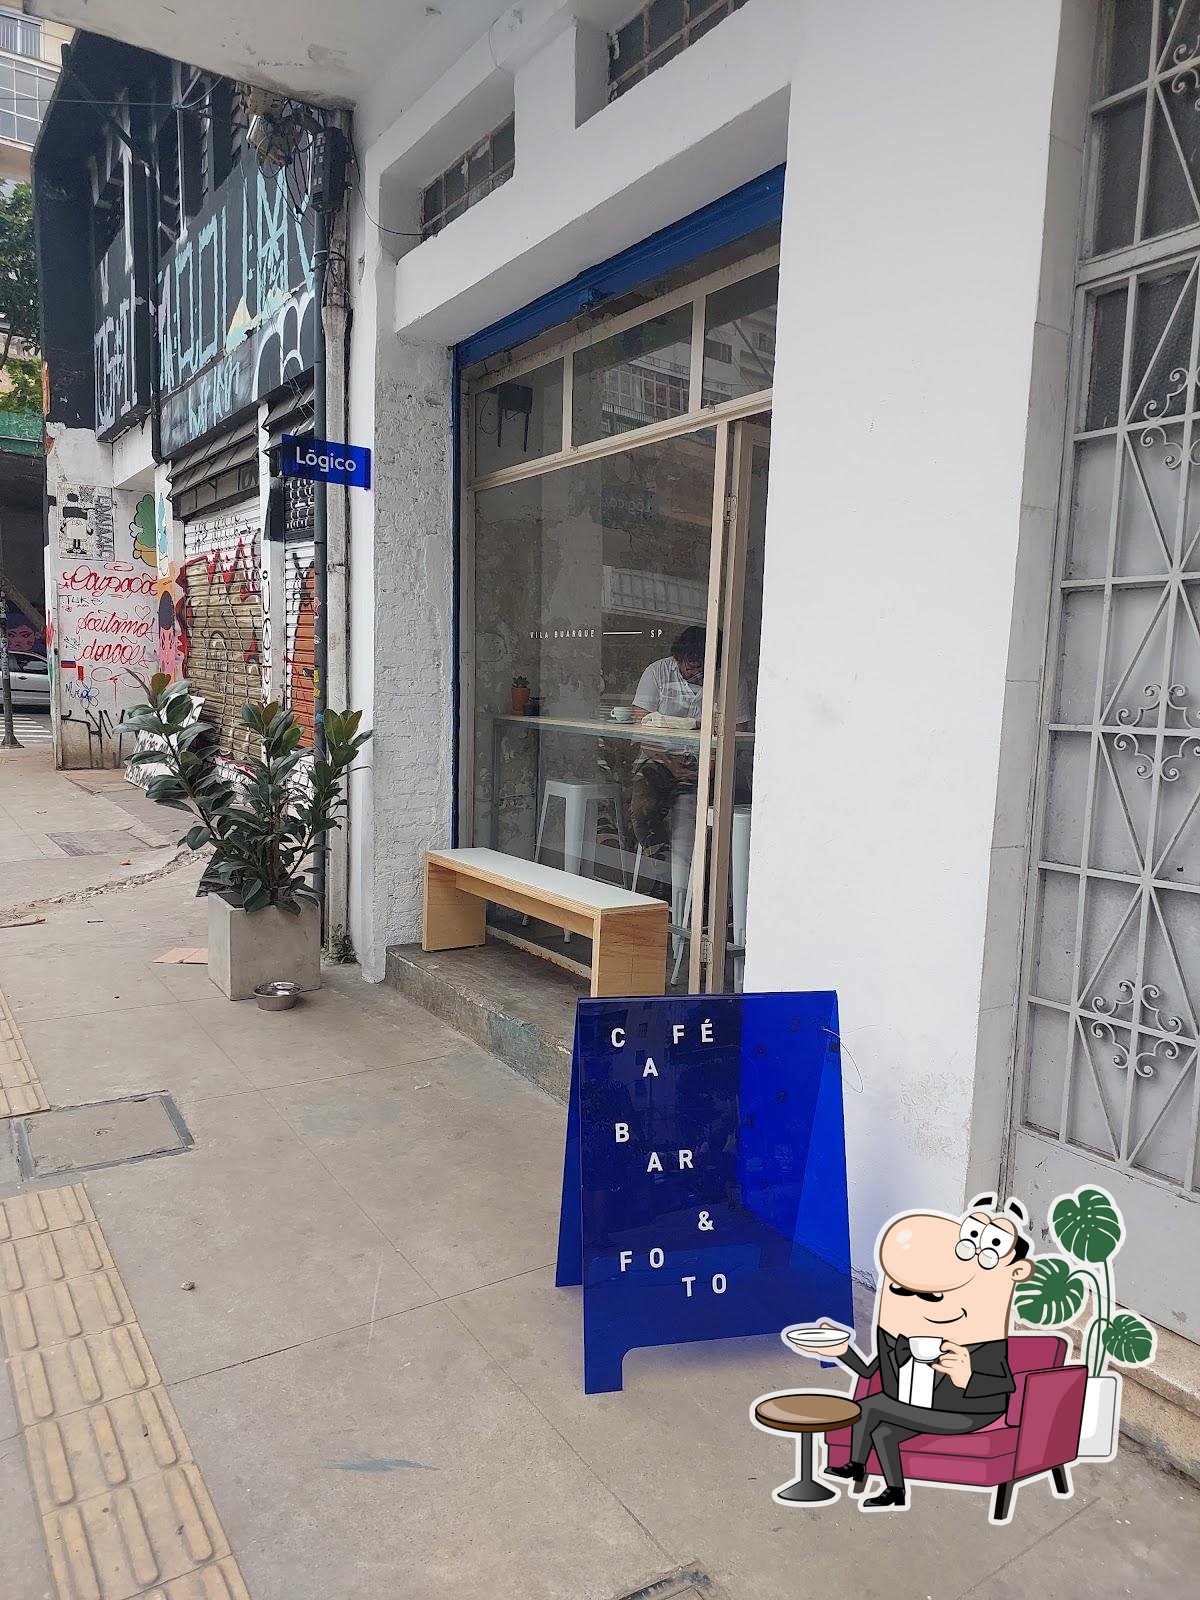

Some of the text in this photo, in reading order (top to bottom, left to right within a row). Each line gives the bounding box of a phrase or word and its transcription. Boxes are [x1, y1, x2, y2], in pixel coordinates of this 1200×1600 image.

[530, 629, 663, 639] VILA BUARQUE SP
[698, 1210, 714, 1231] &
